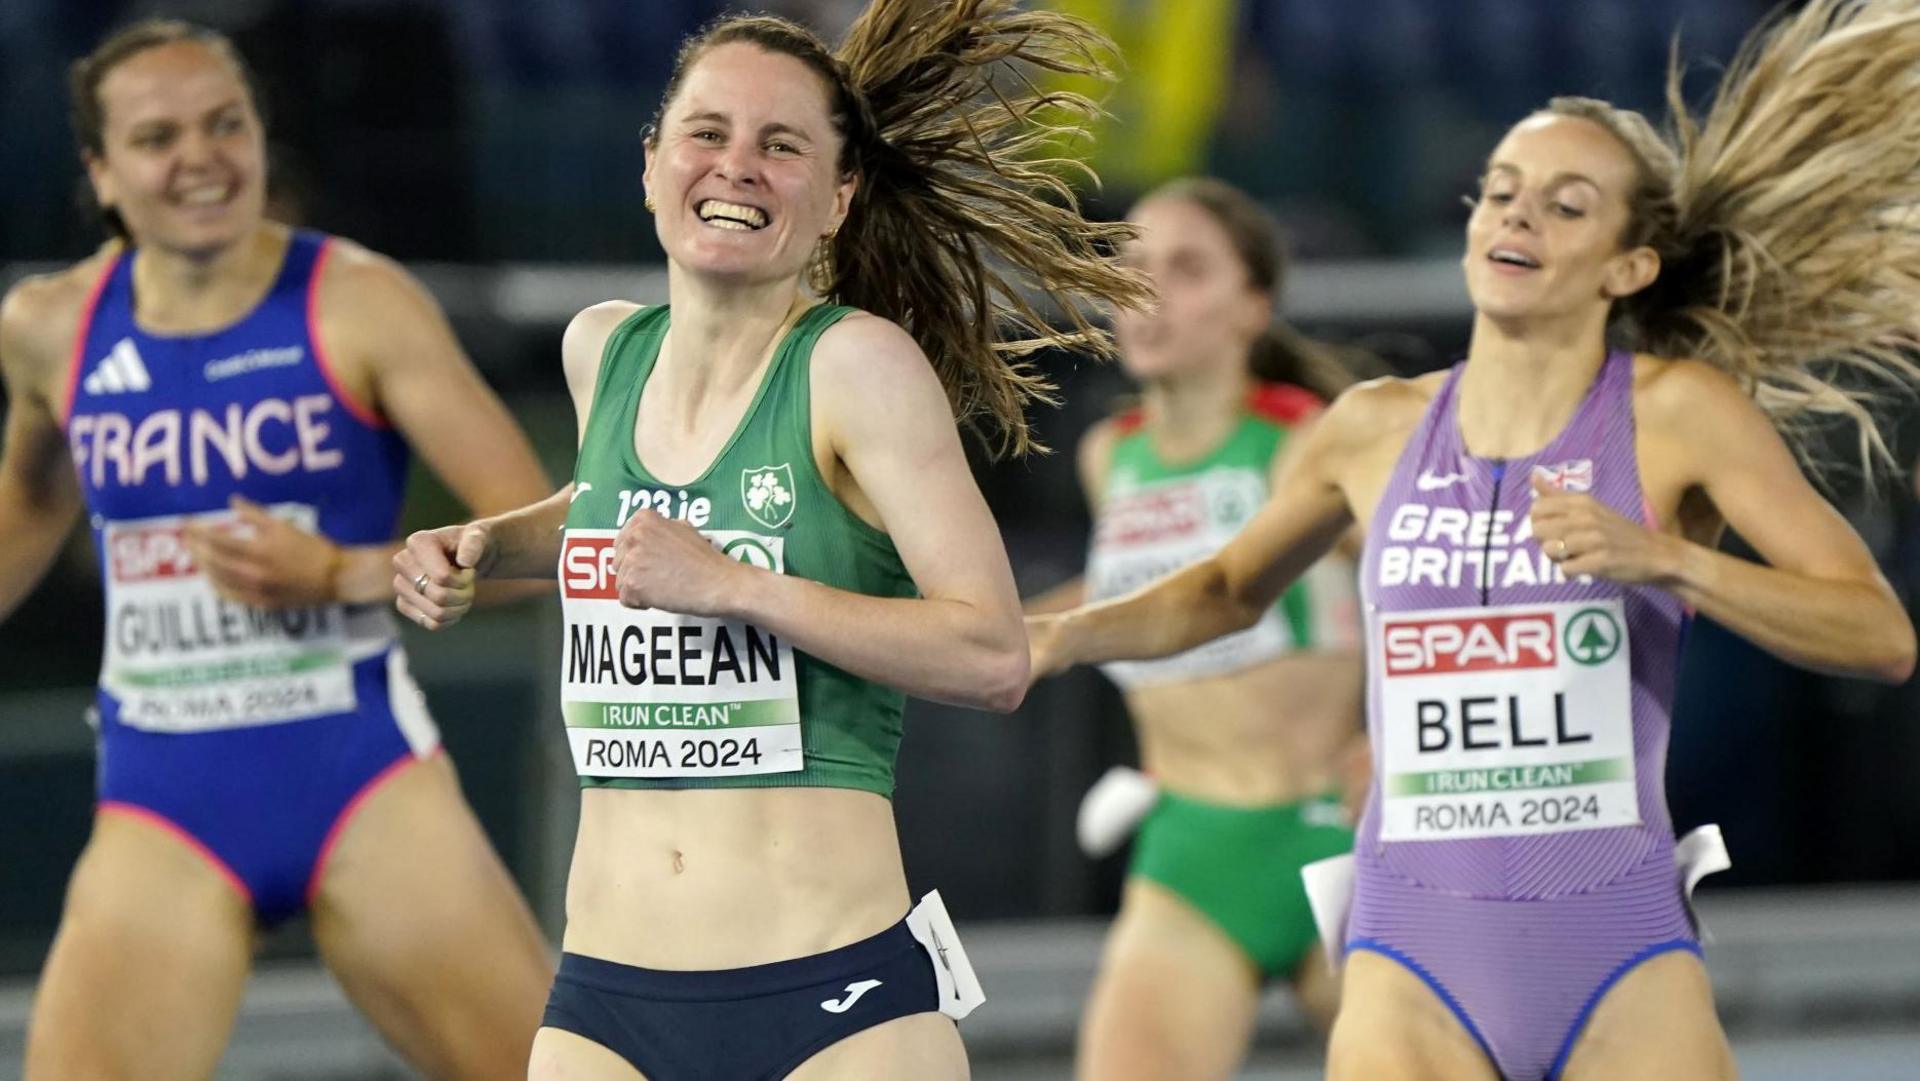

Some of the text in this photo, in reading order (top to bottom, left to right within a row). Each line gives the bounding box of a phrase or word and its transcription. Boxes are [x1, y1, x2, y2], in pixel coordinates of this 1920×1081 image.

[70, 395, 343, 488] FRANCE
[1388, 503, 1534, 548] GRE
[566, 546, 617, 591] SP
[568, 624, 781, 686] MAGEEAN
[1386, 619, 1553, 670] SPAR
[603, 706, 608, 726] I
[609, 706, 649, 726] RUN
[1417, 692, 1592, 754] BELL
[586, 737, 762, 769] ROMA 2024
[1439, 770, 1488, 792] RUN
[1416, 794, 1600, 831] ROMA 2024
